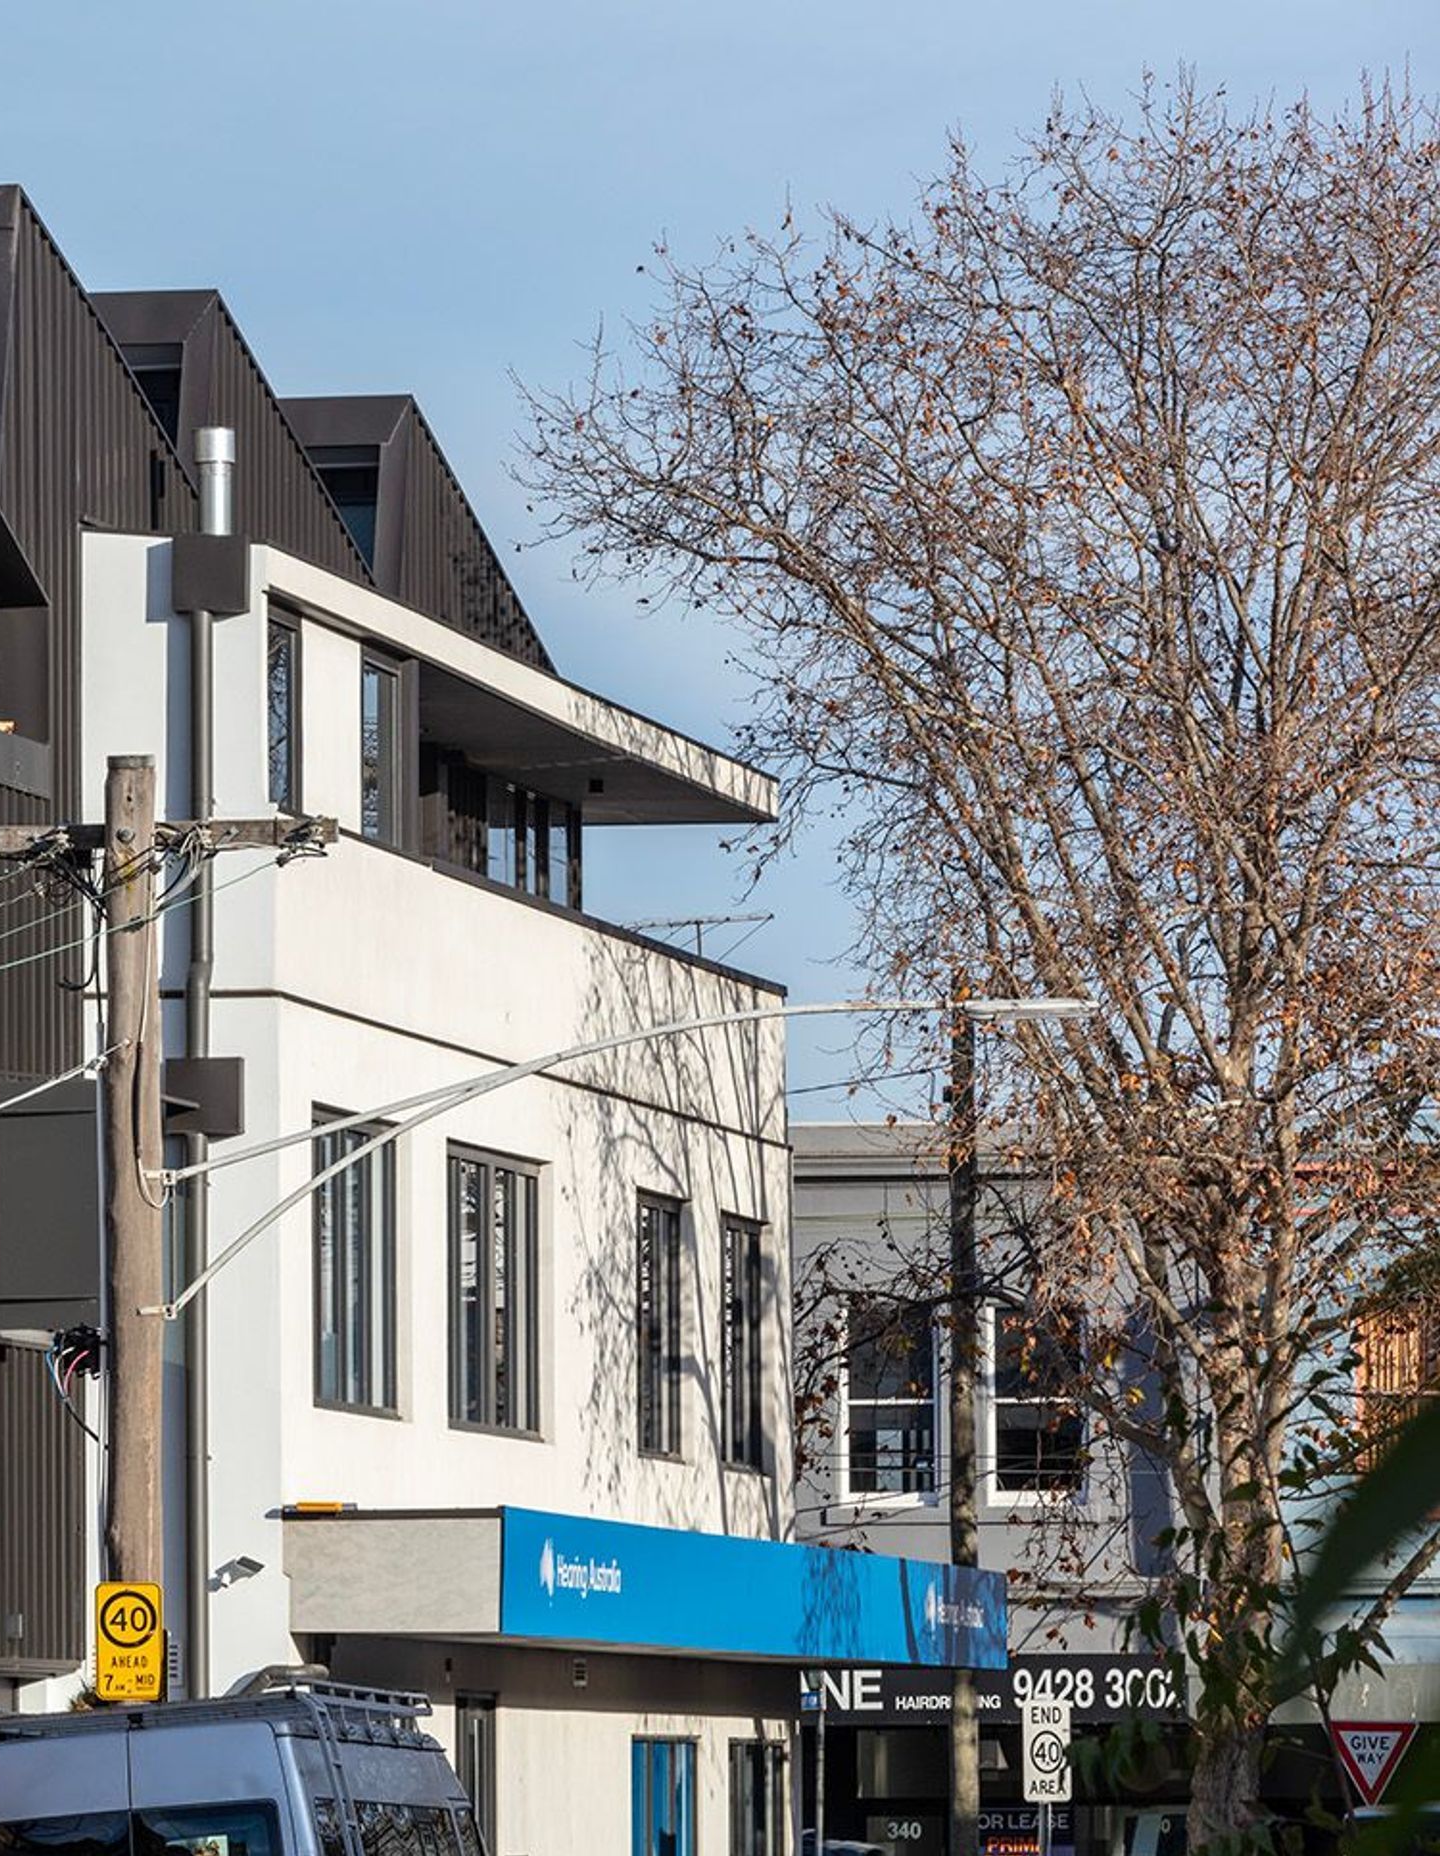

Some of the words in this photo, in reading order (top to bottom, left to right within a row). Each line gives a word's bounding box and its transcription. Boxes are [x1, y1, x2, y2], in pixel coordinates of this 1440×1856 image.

[557, 1553, 588, 1599] Hearing
[110, 1607, 147, 1631] 40
[111, 1656, 148, 1668] AHEAD
[895, 1694, 1001, 1710] HAIRDRNG
[1013, 1668, 1095, 1708] 9428
[1031, 1706, 1062, 1724] END
[1350, 1736, 1390, 1750] GIVE
[1034, 1742, 1059, 1763] 40
[1357, 1753, 1384, 1764] WAY
[1029, 1780, 1066, 1796] AREA
[976, 1813, 1004, 1830] OR
[887, 1822, 922, 1839] 340
